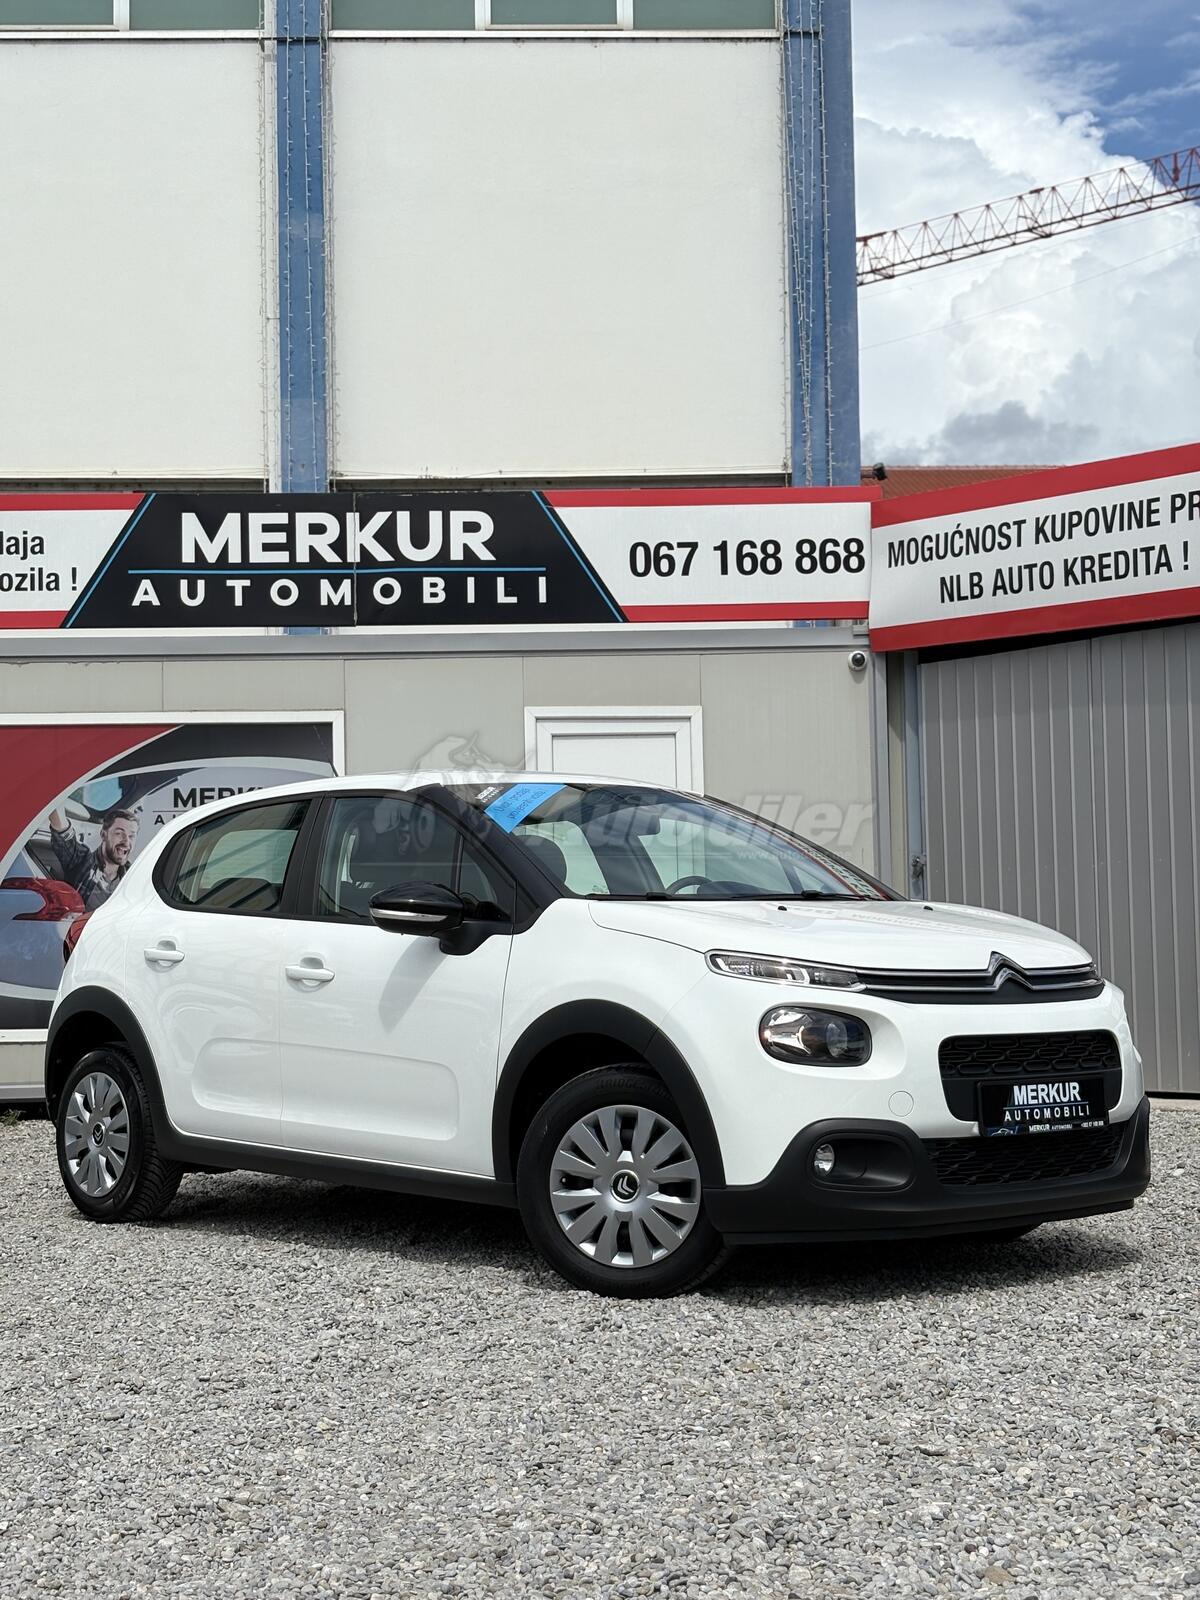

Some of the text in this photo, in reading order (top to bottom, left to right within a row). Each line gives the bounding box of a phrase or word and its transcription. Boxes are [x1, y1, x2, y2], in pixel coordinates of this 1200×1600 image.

[0, 530, 45, 560] aja
[181, 510, 497, 564] MERKUR
[887, 519, 1027, 568] MOGUĆNOST
[1034, 496, 1161, 545] KUPOVINE
[629, 537, 866, 578] 067 168 868
[939, 540, 1189, 604] NLB AUTO KREDITA !
[71, 566, 77, 591] !
[131, 576, 547, 607] AUTOMOBILI
[1013, 1081, 1082, 1105] MERKUR
[1004, 1104, 1090, 1121] AUTOMOBILI
